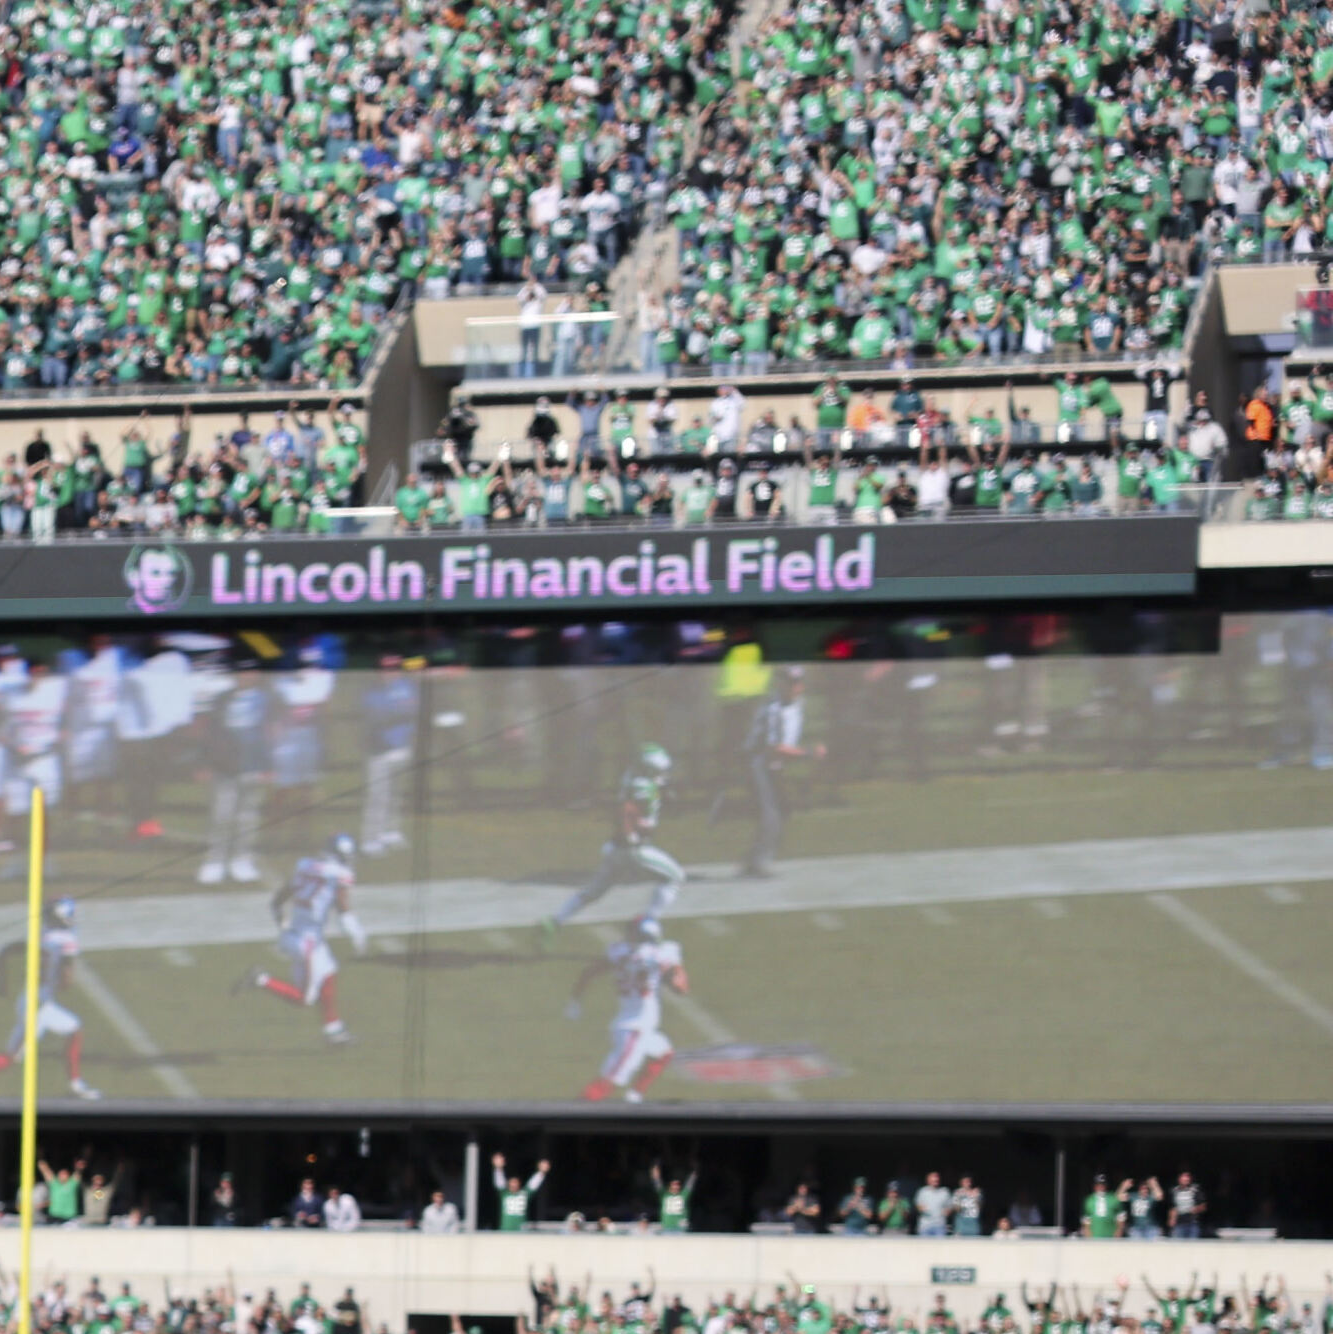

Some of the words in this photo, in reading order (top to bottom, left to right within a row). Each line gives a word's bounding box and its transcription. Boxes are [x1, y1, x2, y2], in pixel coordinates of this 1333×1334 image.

[210, 545, 425, 604] Lincoln
[442, 537, 712, 599] Financial
[726, 532, 876, 594] Field
